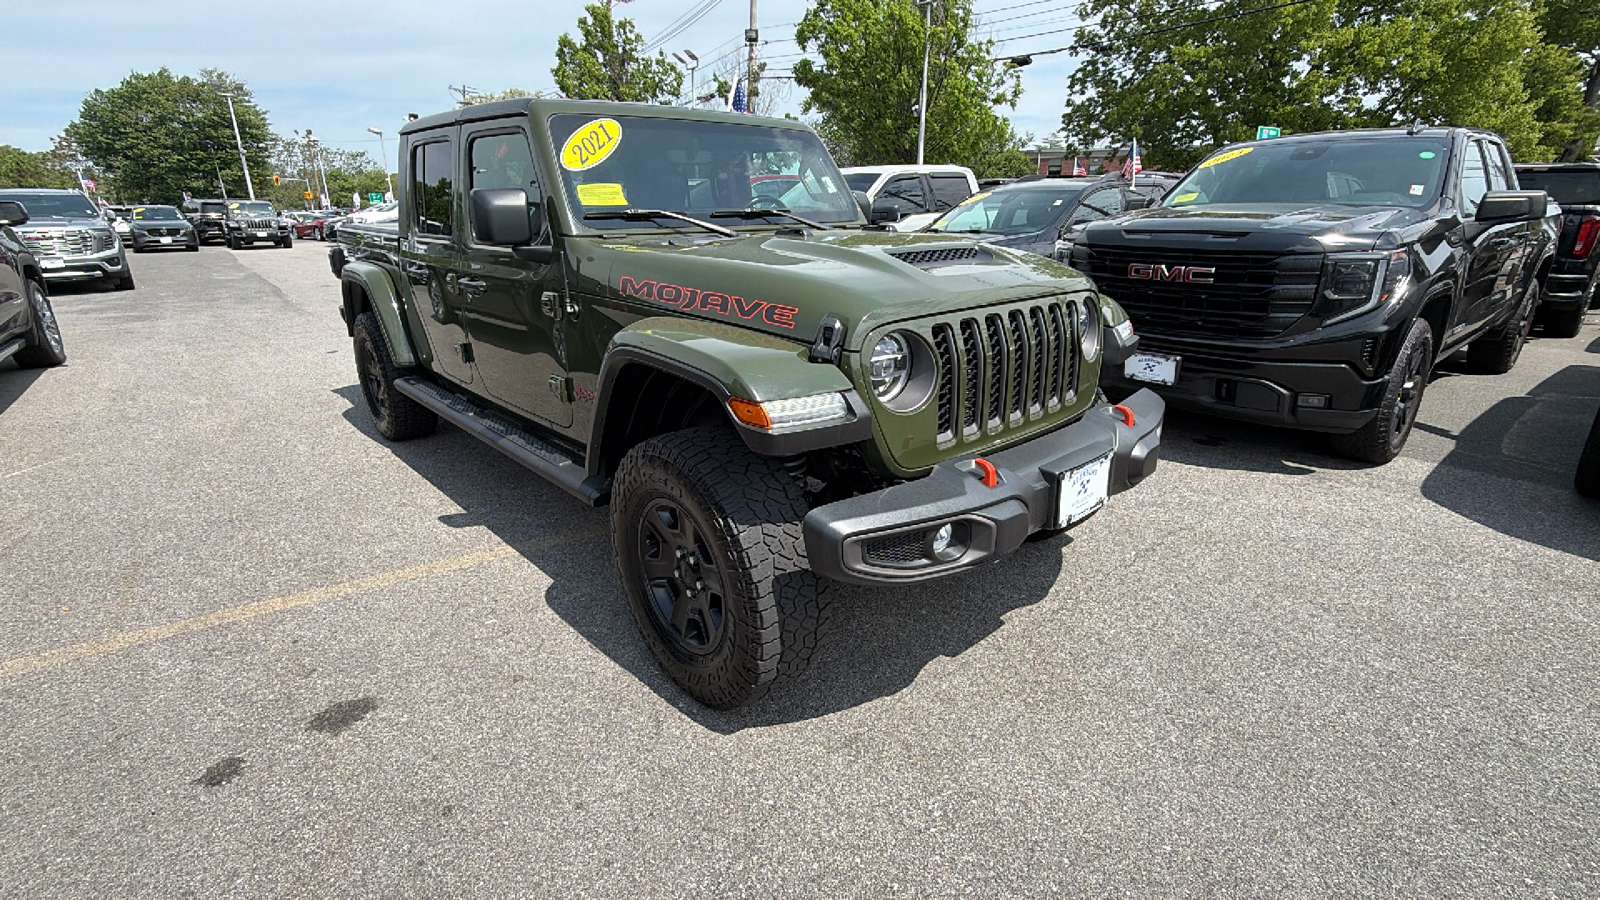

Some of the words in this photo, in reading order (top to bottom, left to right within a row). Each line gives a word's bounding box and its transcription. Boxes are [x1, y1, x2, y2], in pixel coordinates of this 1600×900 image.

[571, 123, 614, 166] 2021
[1128, 262, 1216, 284] GMC
[619, 275, 799, 329] MOJAVE
